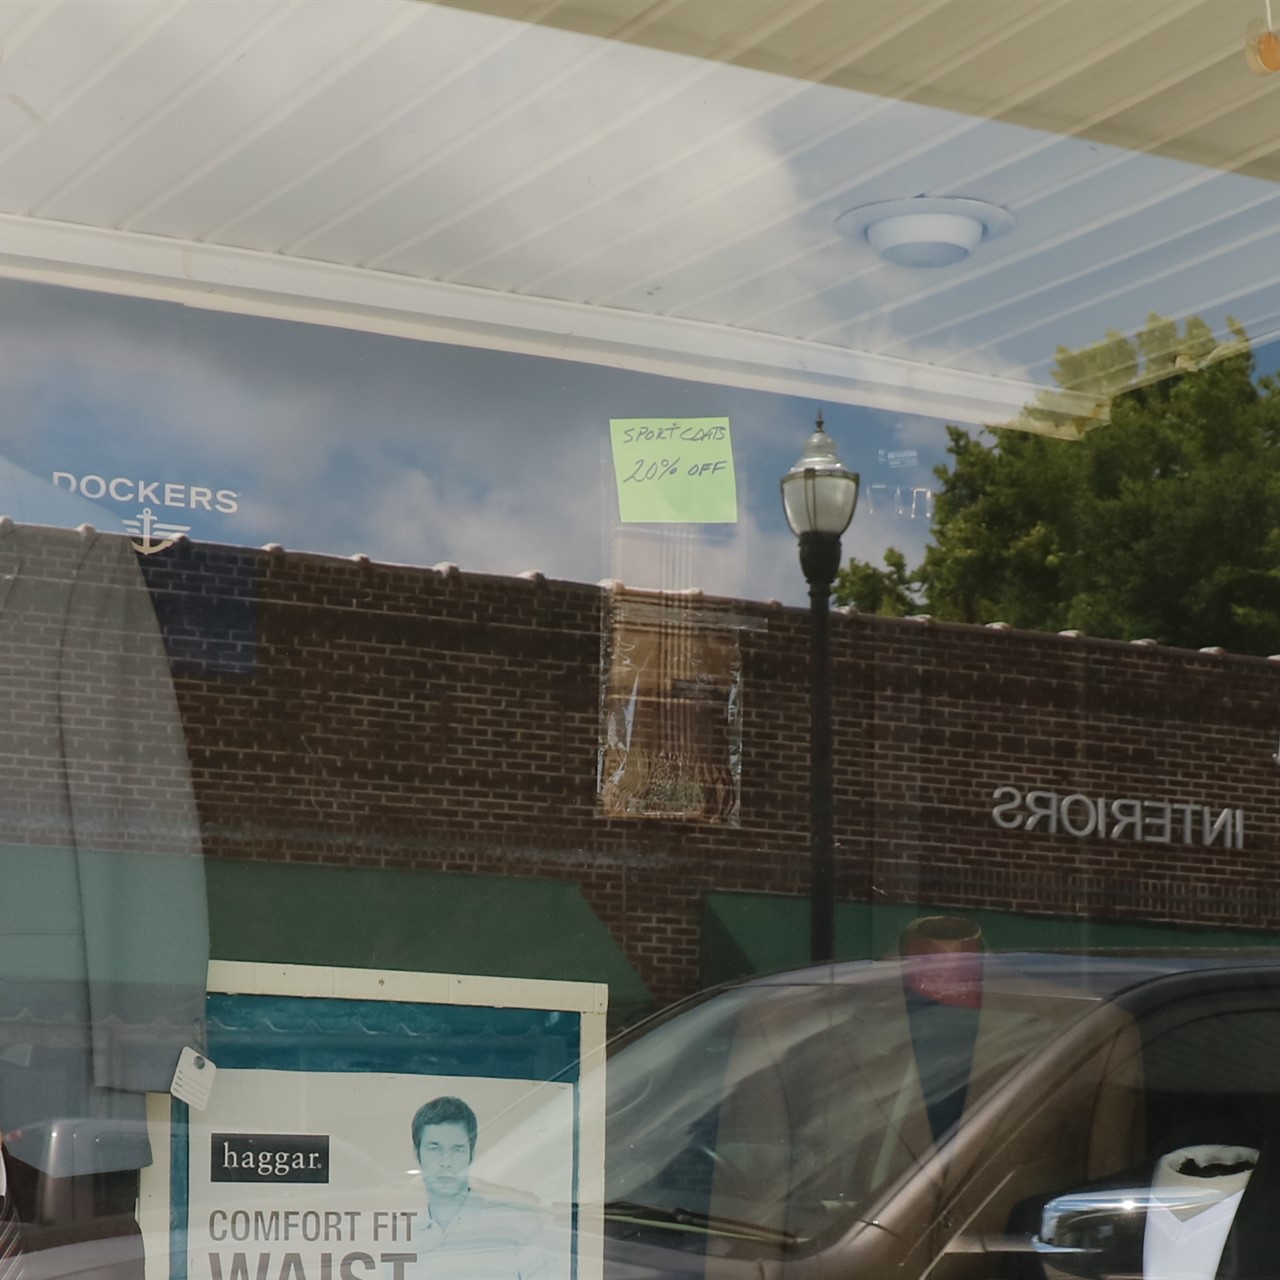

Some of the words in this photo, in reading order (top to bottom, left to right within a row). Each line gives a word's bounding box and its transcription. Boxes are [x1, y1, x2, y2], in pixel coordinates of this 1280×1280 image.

[623, 424, 681, 443] SPORT
[623, 457, 680, 483] 20%
[688, 461, 727, 477] OFF
[52, 471, 238, 513] DOCKERS
[208, 1210, 361, 1242] COMFORT
[372, 1211, 418, 1242] FIT
